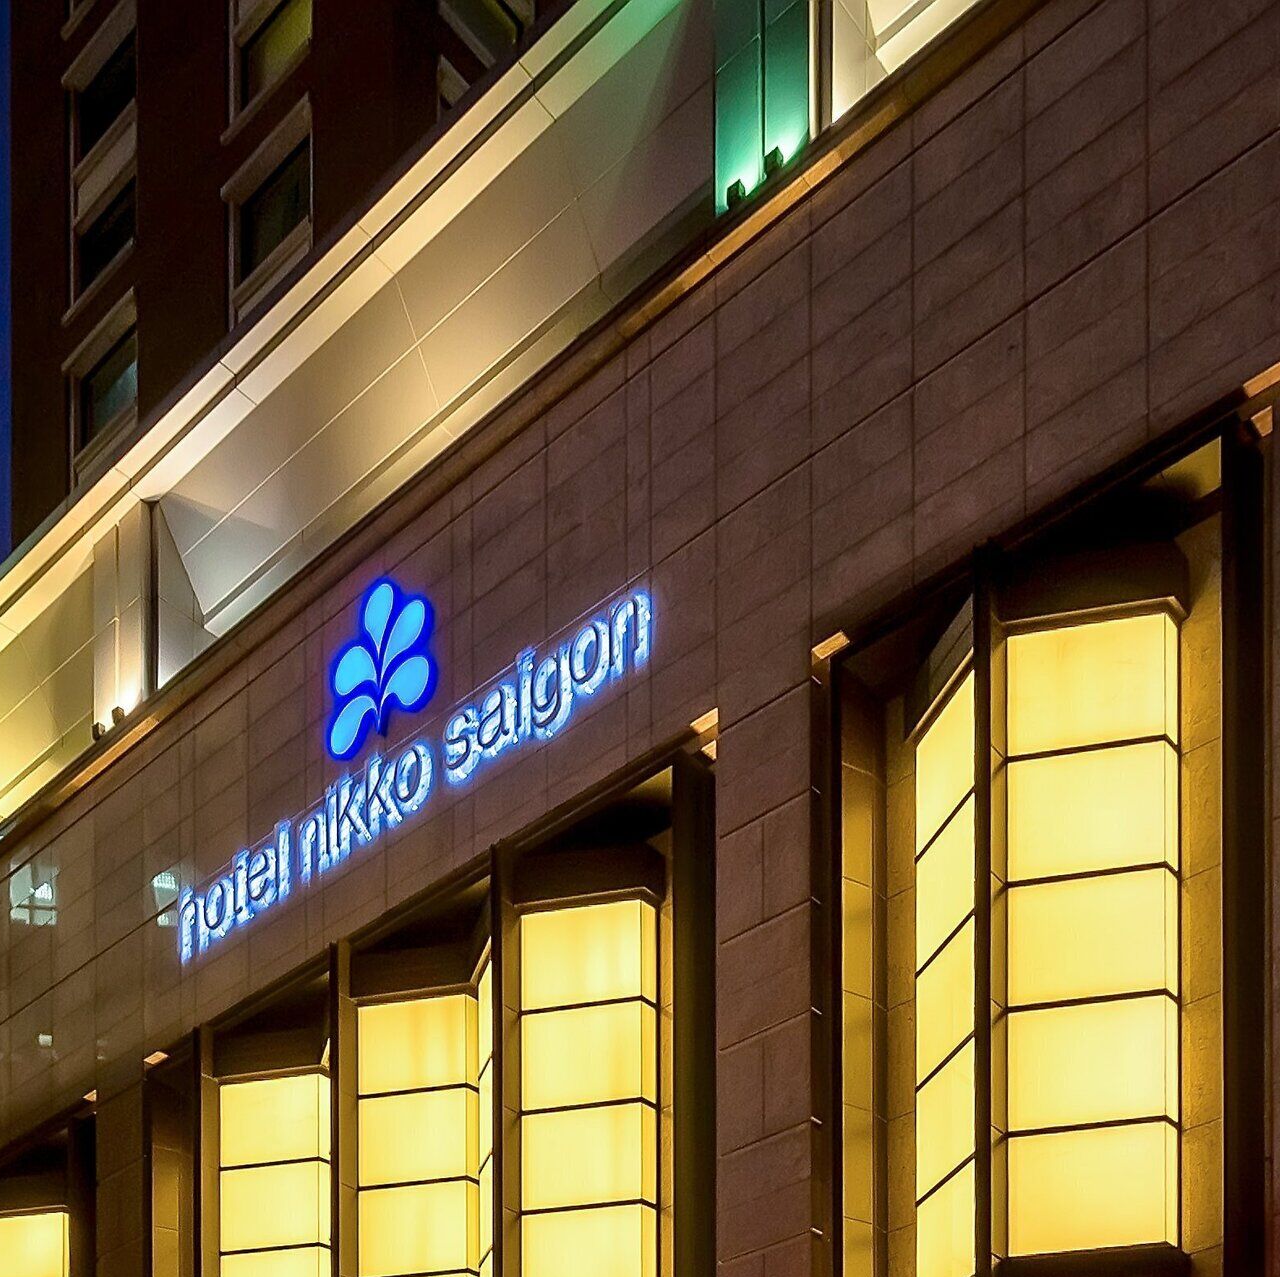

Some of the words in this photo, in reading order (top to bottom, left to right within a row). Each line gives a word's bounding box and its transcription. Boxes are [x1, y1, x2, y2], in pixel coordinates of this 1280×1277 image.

[179, 819, 291, 964] hotel
[300, 749, 433, 885] nikko
[443, 590, 651, 783] saigon
